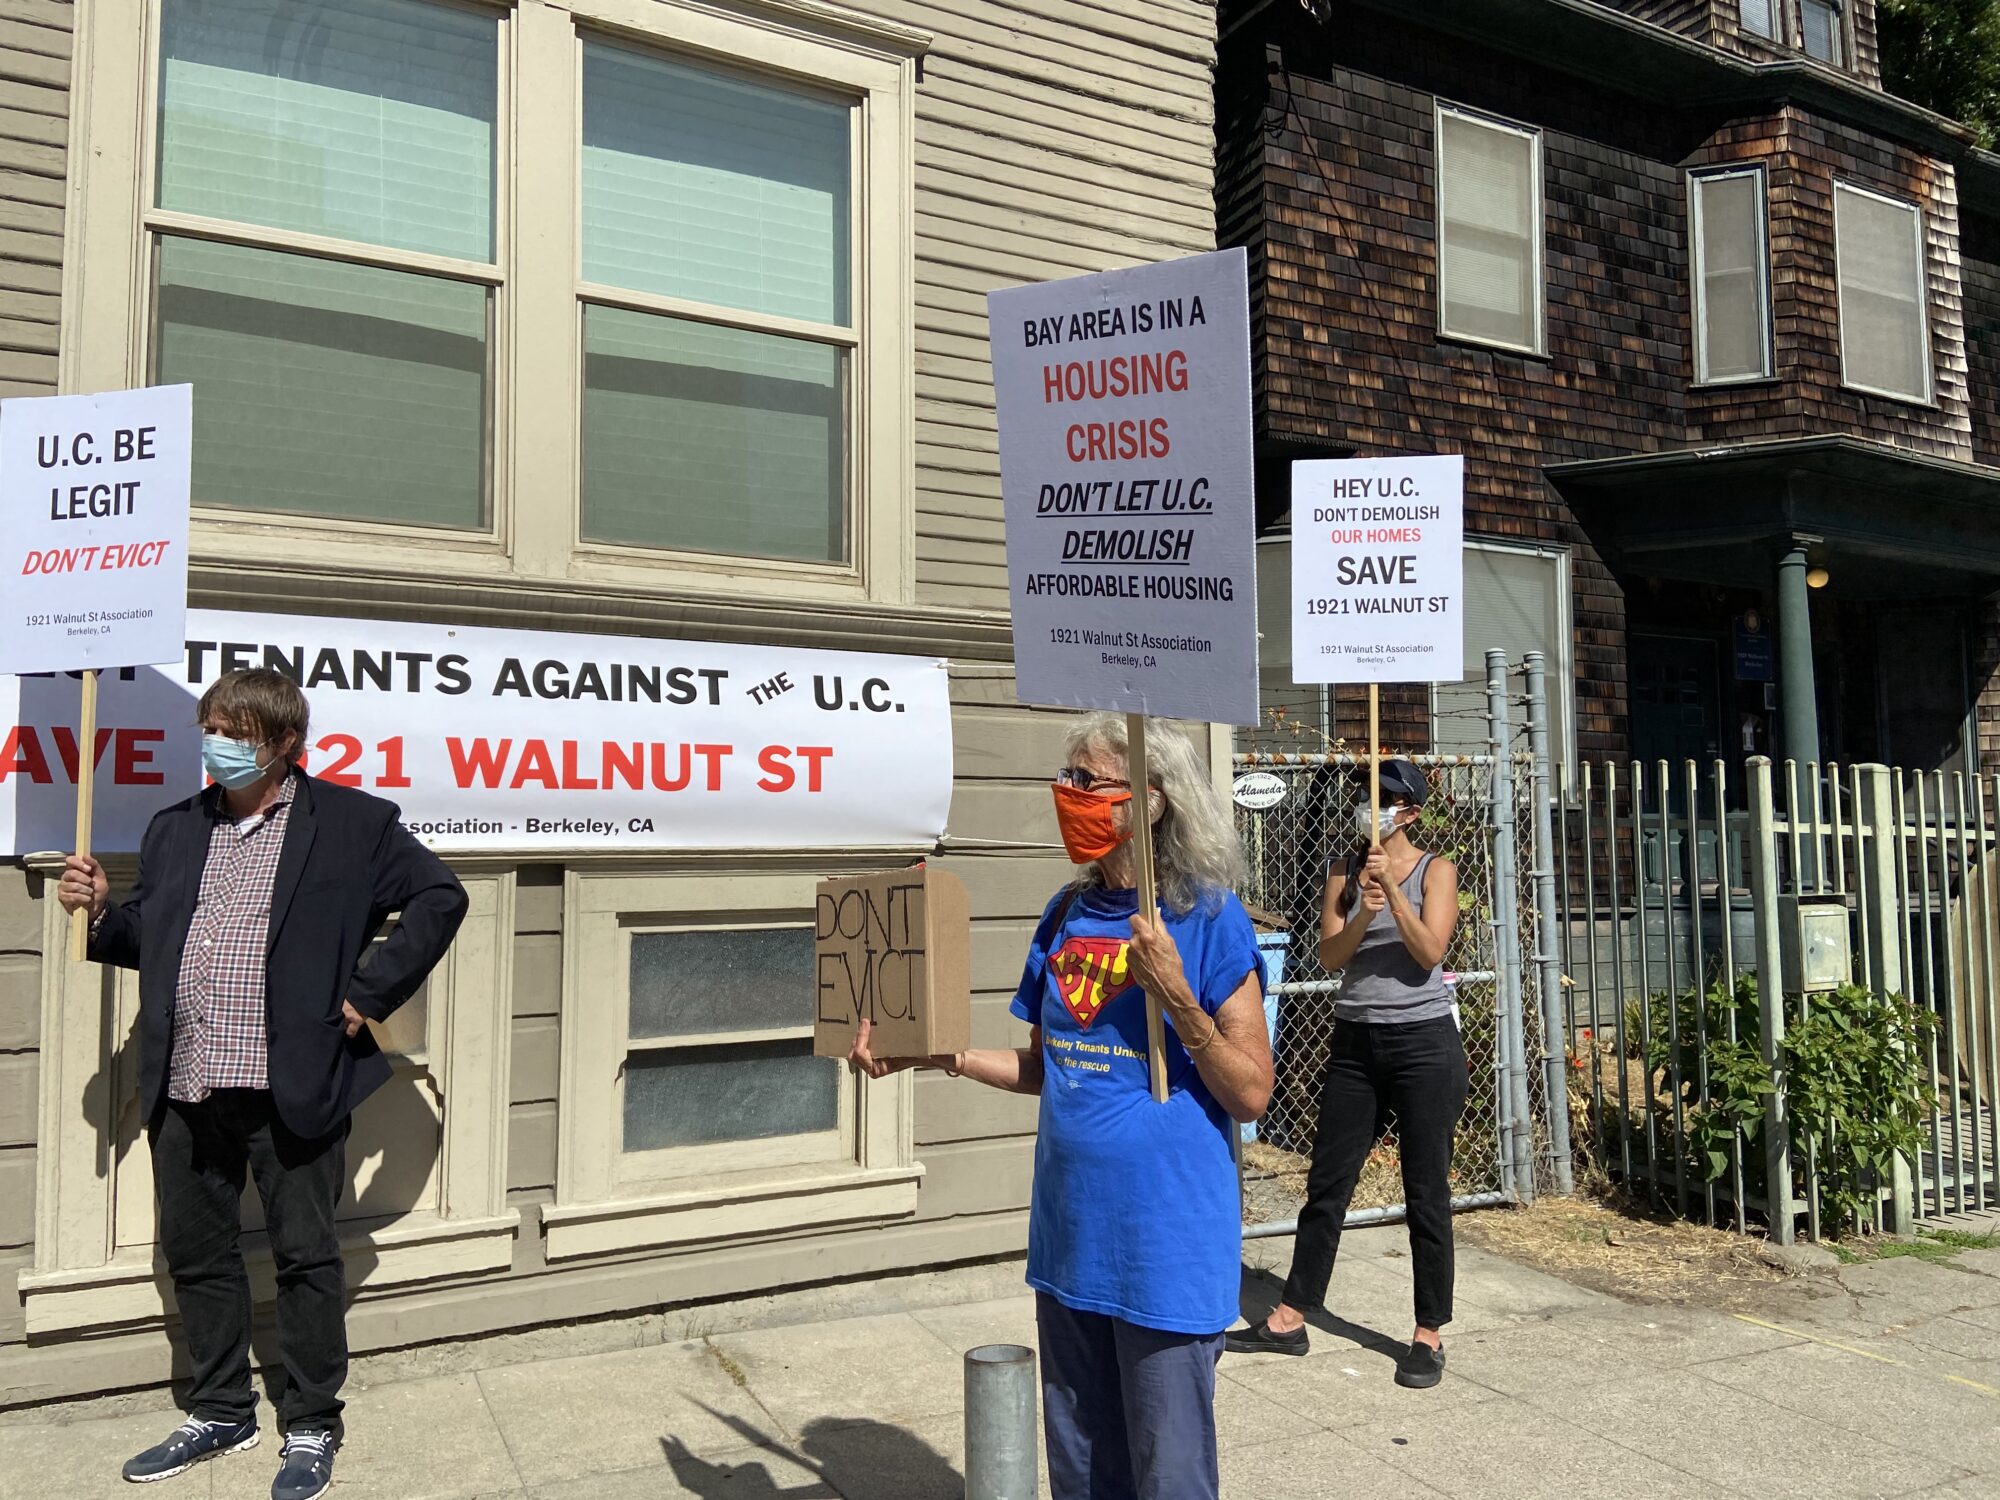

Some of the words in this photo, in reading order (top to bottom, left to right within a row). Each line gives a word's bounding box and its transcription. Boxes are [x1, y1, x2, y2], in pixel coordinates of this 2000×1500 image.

[1024, 316, 1063, 347] BAY
[1069, 308, 1126, 341] AREA
[1132, 304, 1153, 333] IS
[1160, 299, 1182, 329] IN
[1190, 296, 1205, 326] A
[1044, 350, 1188, 403] HOUSING
[38, 433, 101, 468] U.C.
[114, 427, 155, 462] BE
[1067, 418, 1169, 462] CRISIS
[1037, 481, 1113, 514] DON'T
[1115, 480, 1160, 513] LET
[1161, 477, 1213, 511] U.C.
[1334, 479, 1372, 498] HEY
[1378, 477, 1419, 497] U.C.
[51, 482, 140, 520] LEGIT
[1315, 508, 1358, 522] DON'T
[1362, 506, 1439, 521] DEMOLISH
[1062, 529, 1194, 562] DEMOLISH
[1332, 530, 1362, 543] OUR
[1367, 528, 1421, 542] HOMES
[22, 547, 100, 576] DON'T
[100, 541, 170, 570] EVICT
[1337, 556, 1416, 585] SAVE
[1027, 574, 1139, 597] AFFORDABLE
[1144, 576, 1233, 601] HOUSING
[1308, 599, 1349, 614] 1921
[1355, 598, 1424, 613] WALNUT
[1429, 597, 1448, 612] ST
[27, 615, 50, 626] 1921
[54, 613, 85, 624] Walnut
[89, 612, 99, 622] St
[100, 608, 153, 621] Association
[67, 627, 99, 636] Berkeley,
[101, 625, 111, 634] CA
[1051, 629, 1079, 643] 1921
[1083, 630, 1124, 647] Walnut
[1125, 632, 1139, 647] St
[1141, 633, 1212, 652] Association
[1102, 653, 1141, 668] Berkeley,
[1144, 656, 1156, 667] CA
[1344, 645, 1373, 654] Walnut
[1375, 645, 1383, 653] St
[1356, 656, 1386, 665] Berkeley,
[1387, 655, 1396, 663] CA
[184, 641, 473, 695] TENANTS
[492, 658, 728, 705] AGAINST
[746, 672, 794, 705] THE
[814, 676, 904, 712] U.C.
[446, 738, 732, 791] WALNUT
[757, 745, 833, 792] ST
[1235, 783, 1281, 797] Alameda
[401, 819, 502, 834] sociation
[526, 818, 619, 835] Berkeley,
[628, 819, 654, 832] CA
[1075, 1041, 1109, 1054] Tenants
[1113, 1045, 1146, 1060] Union
[1064, 1056, 1077, 1069] the
[1078, 1060, 1110, 1072] rescue
